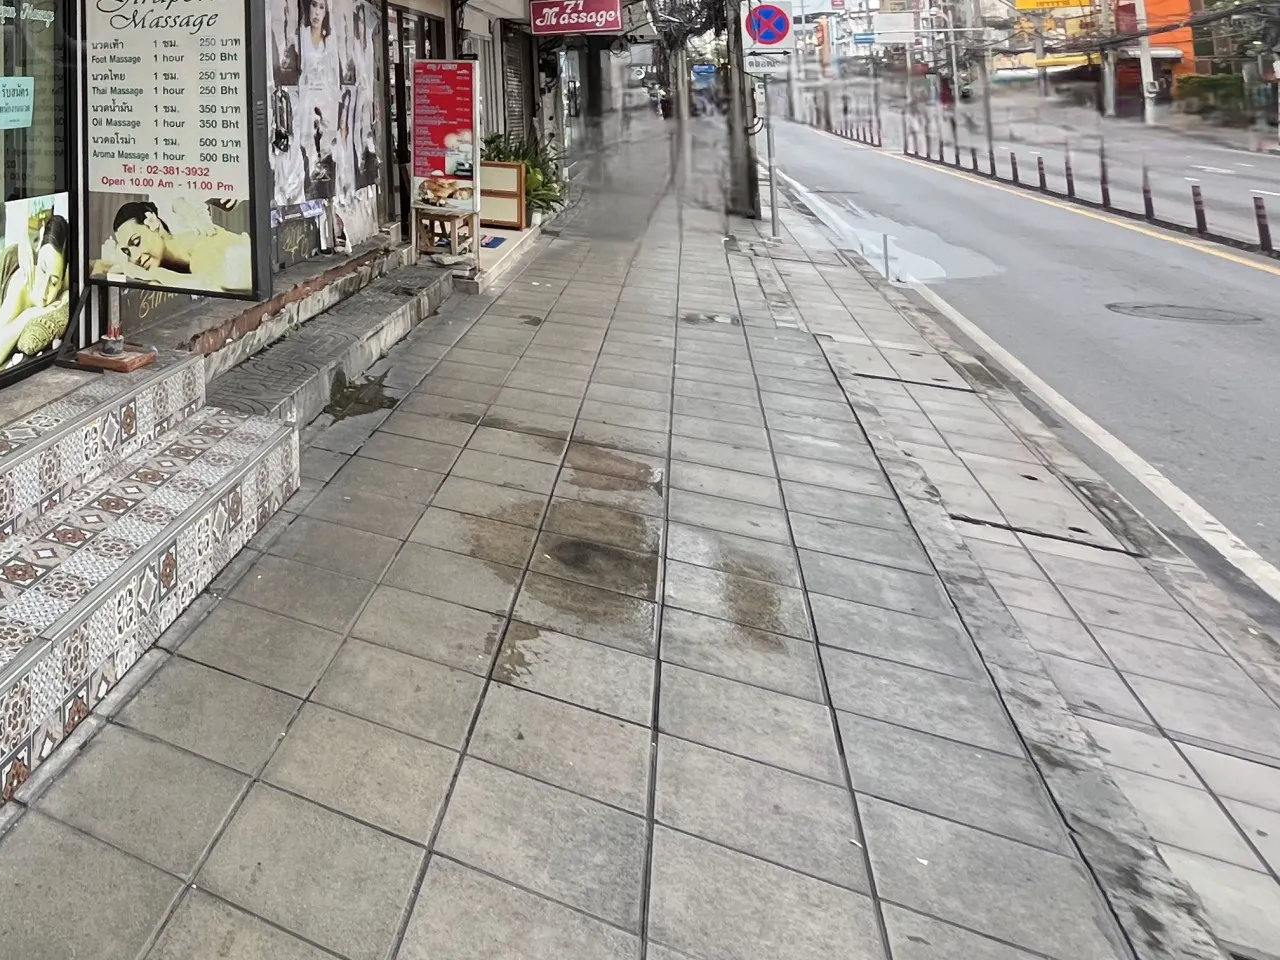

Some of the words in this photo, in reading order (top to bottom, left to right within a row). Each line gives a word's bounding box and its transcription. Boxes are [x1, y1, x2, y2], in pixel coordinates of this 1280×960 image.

[563, 0, 585, 13] 71
[110, 9, 219, 35] Massage
[535, 6, 616, 27] Massage
[91, 39, 124, 50] นวดเท้า
[153, 40, 158, 48] 1
[162, 40, 179, 48] ชม.
[199, 38, 216, 47] 250
[220, 38, 241, 47] บาท
[91, 55, 107, 63] Foot
[109, 55, 141, 64] Massage
[153, 54, 158, 62] 1
[162, 54, 184, 62] hour
[199, 53, 216, 61] 250
[220, 52, 238, 61] Bht
[91, 68, 126, 81] นวดไทย
[153, 72, 158, 80] 1
[162, 72, 179, 81] ชม.
[198, 71, 216, 80] 250
[219, 71, 240, 80] บาท
[92, 86, 107, 95] Thai
[110, 86, 144, 97] Massage
[153, 86, 158, 95] 1
[162, 86, 185, 95] hour
[199, 86, 216, 95] 250
[220, 85, 238, 95] Bht
[91, 99, 133, 113] นวดน้ำมัน
[153, 105, 158, 113] 1
[163, 105, 180, 113] ชม.
[198, 104, 217, 114] 350
[220, 105, 241, 114] บาท
[92, 118, 103, 127] Oil
[105, 118, 141, 129] Massage
[153, 119, 158, 128] 1
[163, 119, 186, 128] hour
[199, 120, 217, 129] 350
[221, 120, 240, 129] Bht
[92, 132, 136, 145] นวดอโรม่า
[153, 137, 159, 145] 1
[163, 138, 180, 146] ชม.
[199, 138, 218, 147] 500
[221, 138, 242, 148] บาท
[92, 150, 115, 159] Aroma
[118, 150, 150, 161] Massage
[153, 152, 158, 161] 1
[162, 152, 186, 161] hour
[199, 153, 218, 162] 500
[221, 153, 240, 163] Bht
[122, 164, 136, 174] Tel
[146, 165, 210, 177] 02-381-3932
[101, 176, 125, 187] Open
[130, 177, 154, 187] 10.00
[157, 179, 174, 189] Am
[186, 181, 213, 191] 11.00
[217, 182, 234, 192] Pm
